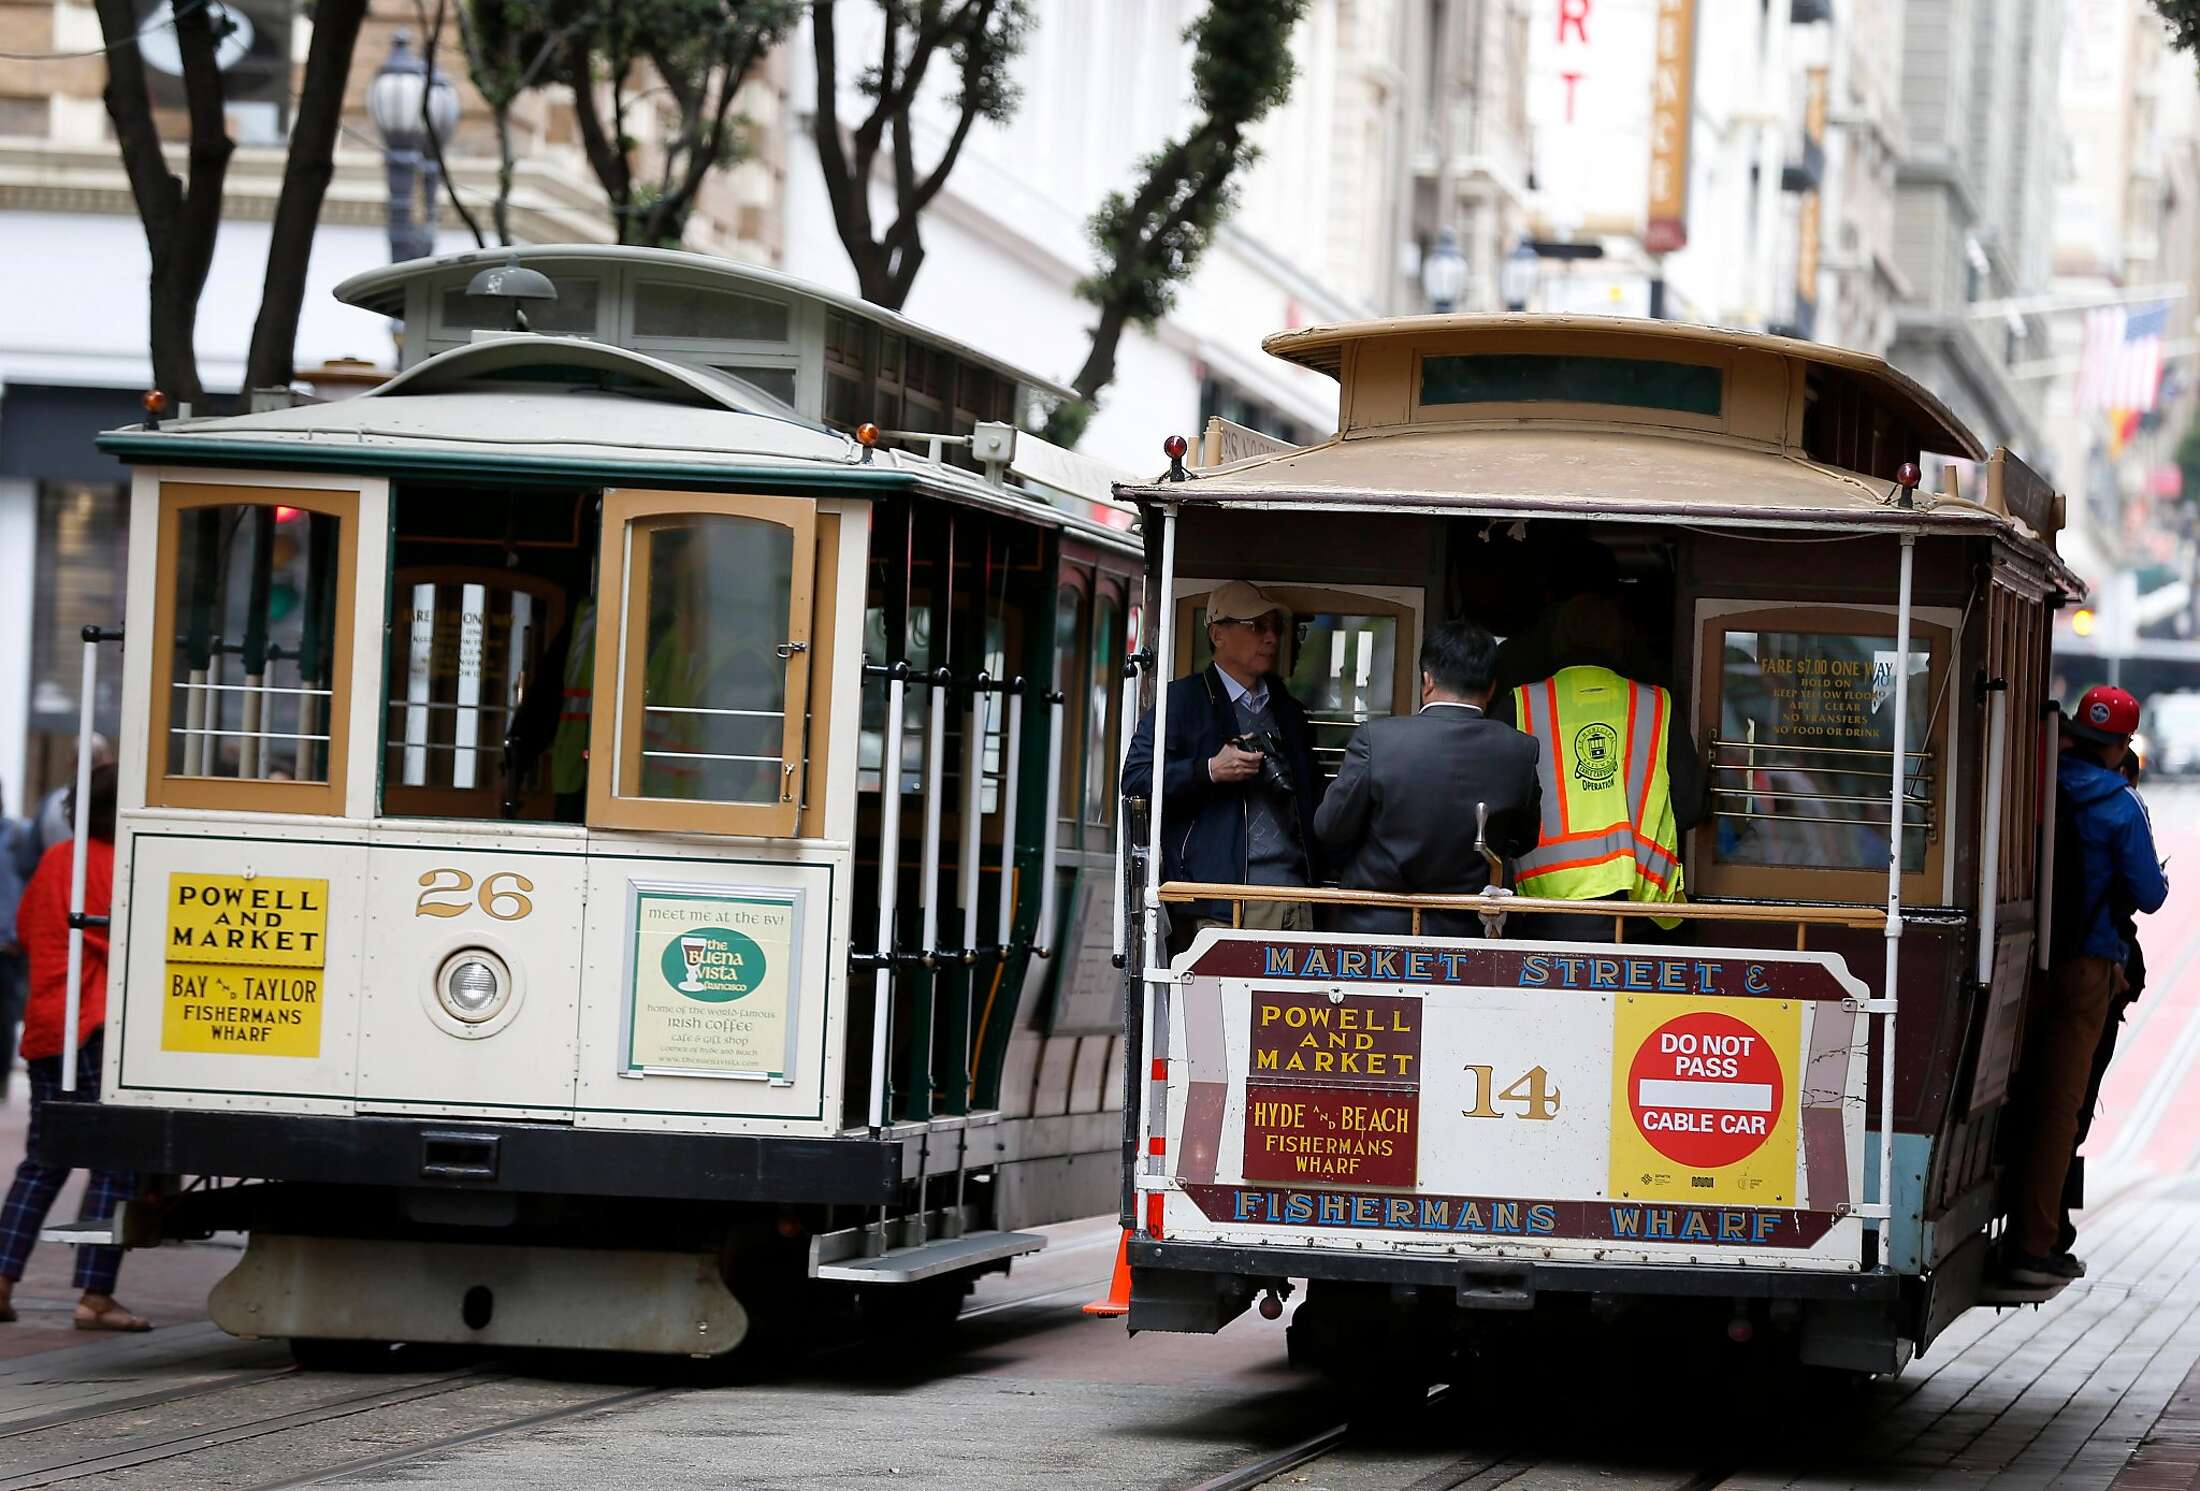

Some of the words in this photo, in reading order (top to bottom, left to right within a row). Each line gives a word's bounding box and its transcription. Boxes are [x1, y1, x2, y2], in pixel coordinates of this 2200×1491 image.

[1761, 658, 1792, 674] FARE
[1831, 660, 1859, 676] ONE
[1865, 661, 1894, 678] WAY
[1801, 679, 1830, 688] HOLD
[1835, 679, 1852, 688] ON
[1824, 703, 1861, 712] CLEAR
[1793, 726, 1823, 735] FOOD
[1827, 727, 1843, 736] OR
[1846, 728, 1880, 738] DRINK
[179, 886, 318, 911] POWELL
[415, 868, 534, 921] 26
[214, 912, 282, 927] AND
[736, 912, 759, 924] the
[173, 927, 319, 951] MARKET
[706, 939, 728, 951] the
[1264, 945, 1467, 981] MARKET
[1519, 954, 1723, 991] STREET
[1744, 965, 1771, 993] &
[172, 974, 209, 998] BAY
[244, 977, 317, 1003] TAYLOR
[184, 1004, 301, 1025] FISHERMANS
[1261, 1005, 1411, 1032] POWELL
[211, 1025, 272, 1042] WHARF
[1300, 1031, 1374, 1050] AND
[1661, 1033, 1697, 1055] DO
[1702, 1035, 1755, 1057] NOT
[1256, 1049, 1413, 1075] MARKET
[1675, 1056, 1738, 1079] PASS
[1462, 1064, 1561, 1121] 14
[1254, 1102, 1306, 1128] HYDE
[1313, 1105, 1336, 1130] AND
[1341, 1106, 1409, 1133] BEACH
[1643, 1111, 1714, 1133] CABLE
[1720, 1114, 1766, 1135] CAR
[1265, 1134, 1393, 1157] FISHERMANS
[1295, 1156, 1361, 1175] WHARF
[1233, 1190, 1557, 1234] FISHERMANS
[1610, 1206, 1782, 1243] WHARF
